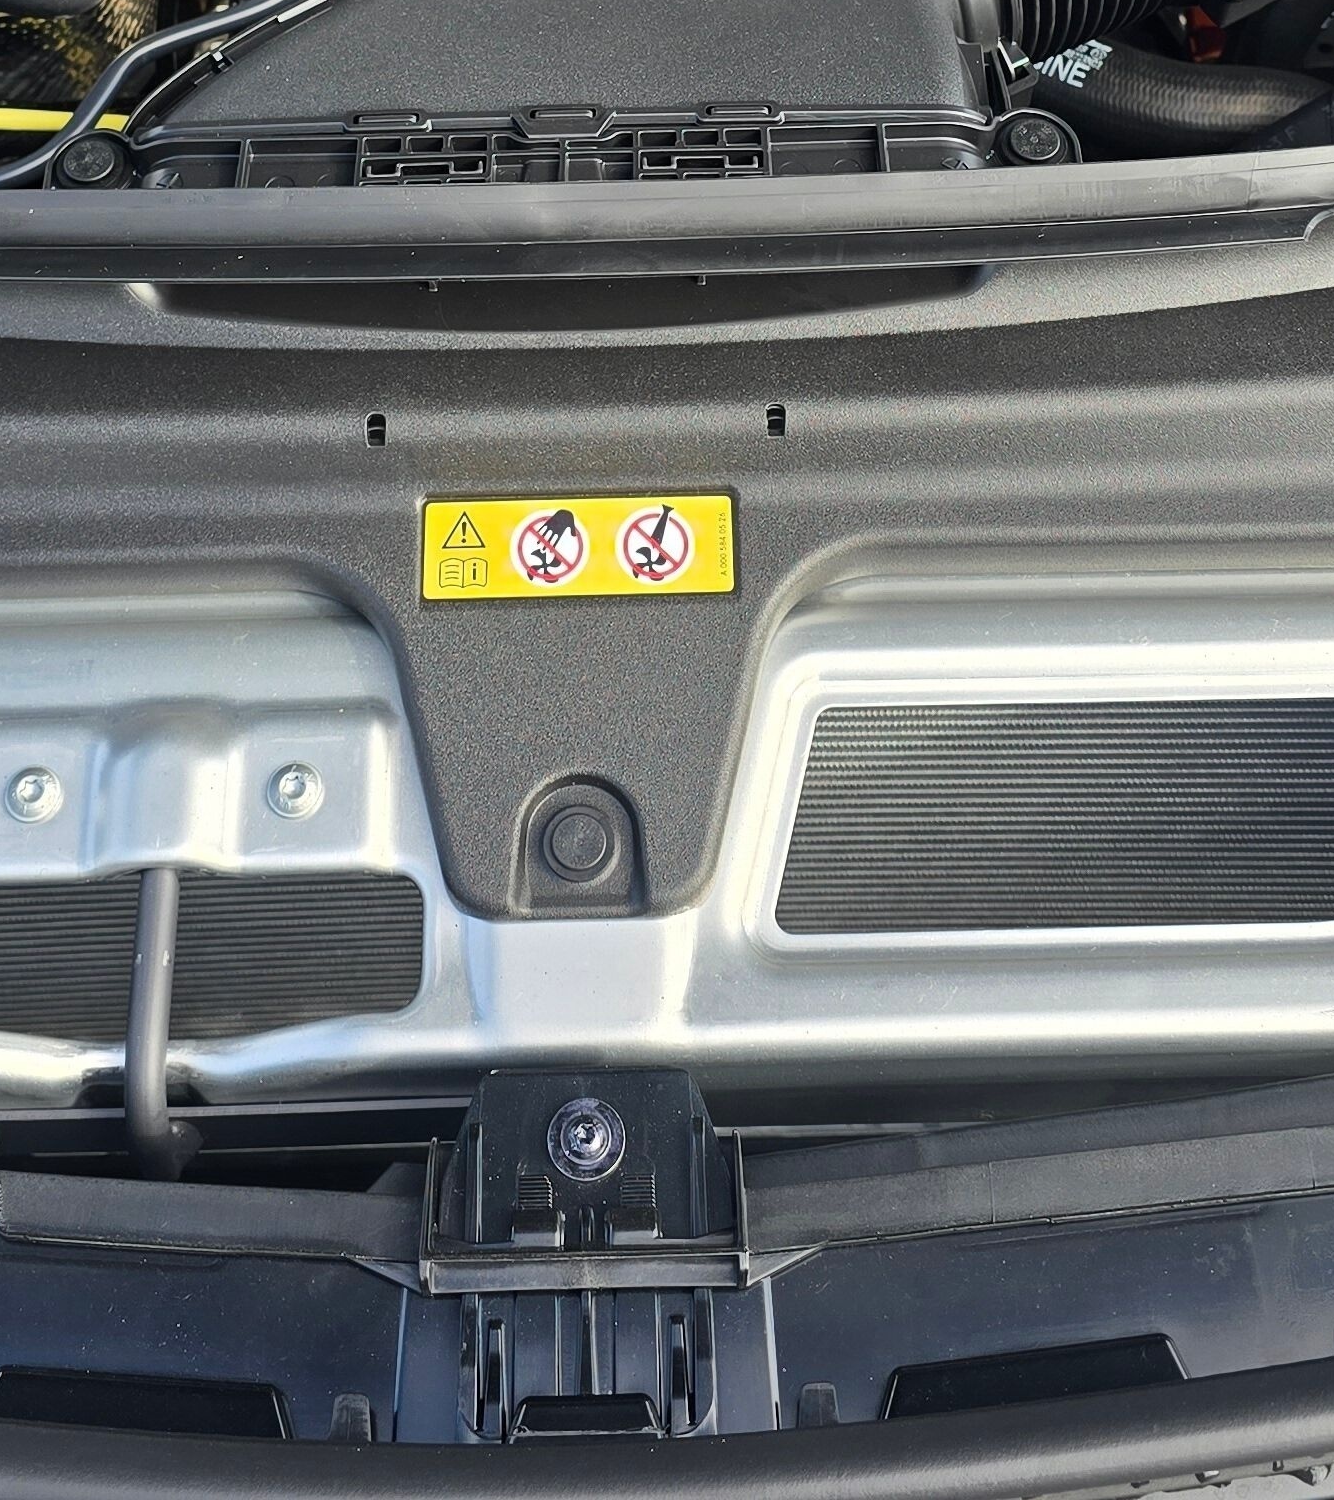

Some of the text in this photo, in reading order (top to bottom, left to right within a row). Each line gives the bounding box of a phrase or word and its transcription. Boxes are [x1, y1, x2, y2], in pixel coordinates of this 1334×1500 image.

[718, 524, 727, 534] 05
[719, 536, 727, 551] 584
[719, 553, 727, 569] 000
